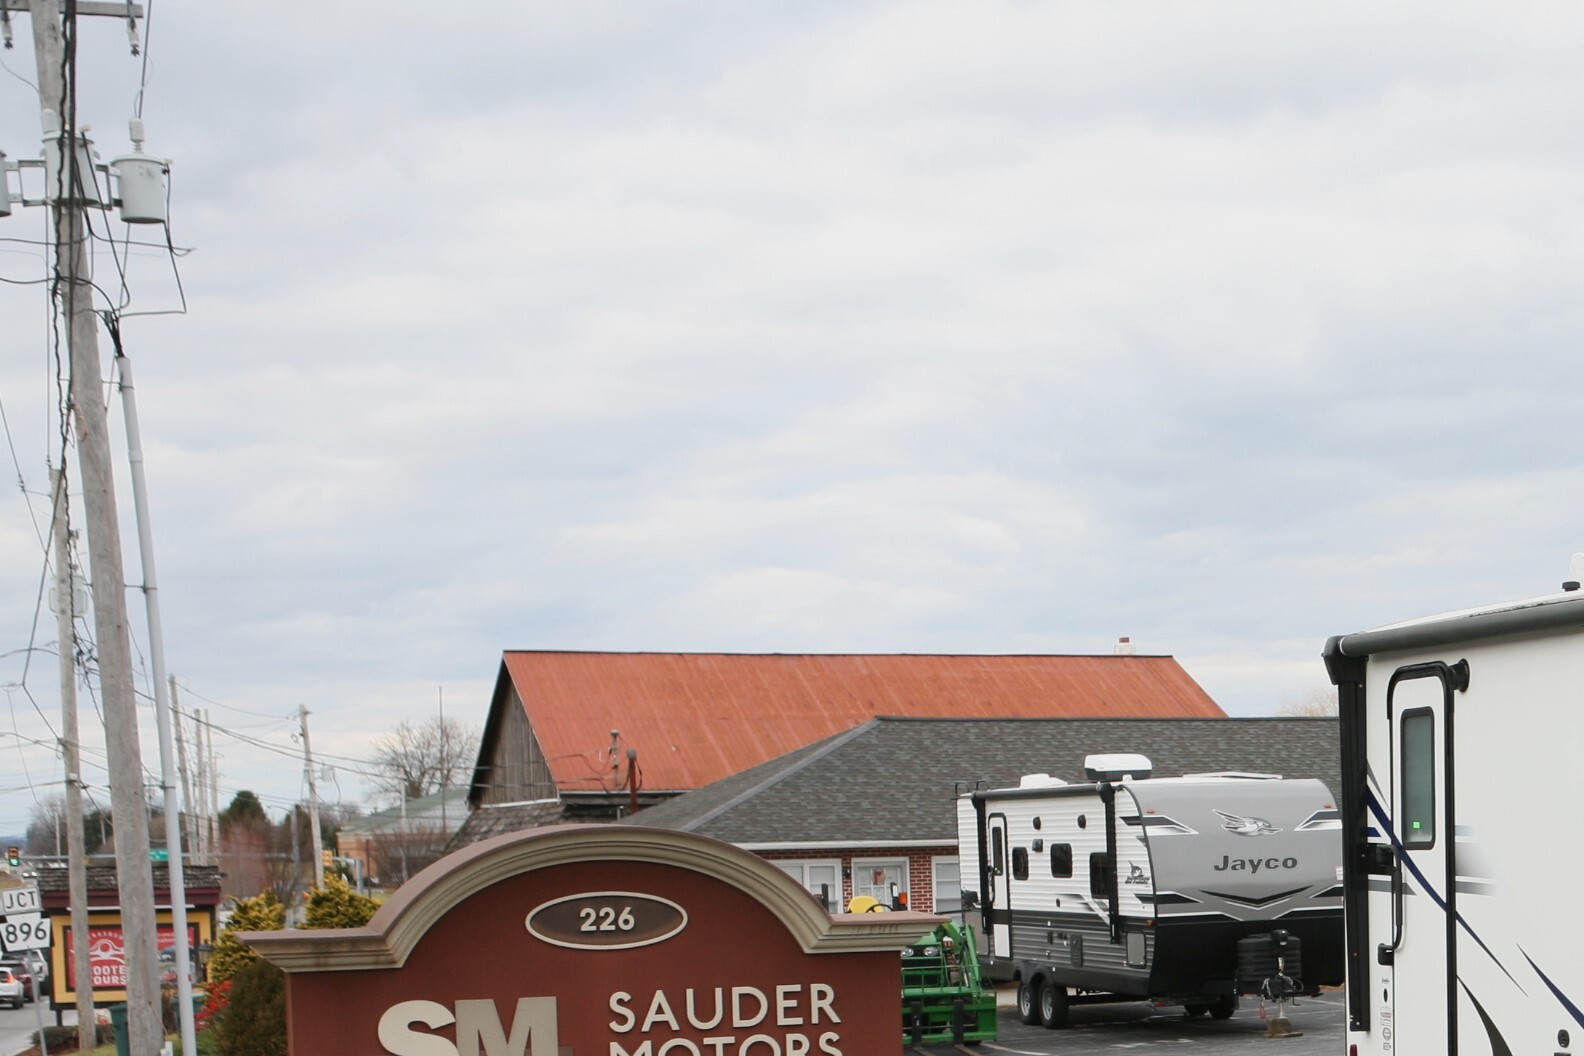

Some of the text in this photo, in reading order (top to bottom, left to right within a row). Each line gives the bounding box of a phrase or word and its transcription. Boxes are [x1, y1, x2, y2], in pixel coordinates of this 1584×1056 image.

[1213, 854, 1299, 875] Jayco
[6, 891, 36, 909] JCT
[579, 906, 636, 932] 226
[5, 921, 47, 944] 896
[92, 975, 127, 986] OURS
[608, 983, 842, 1033] SAUDER
